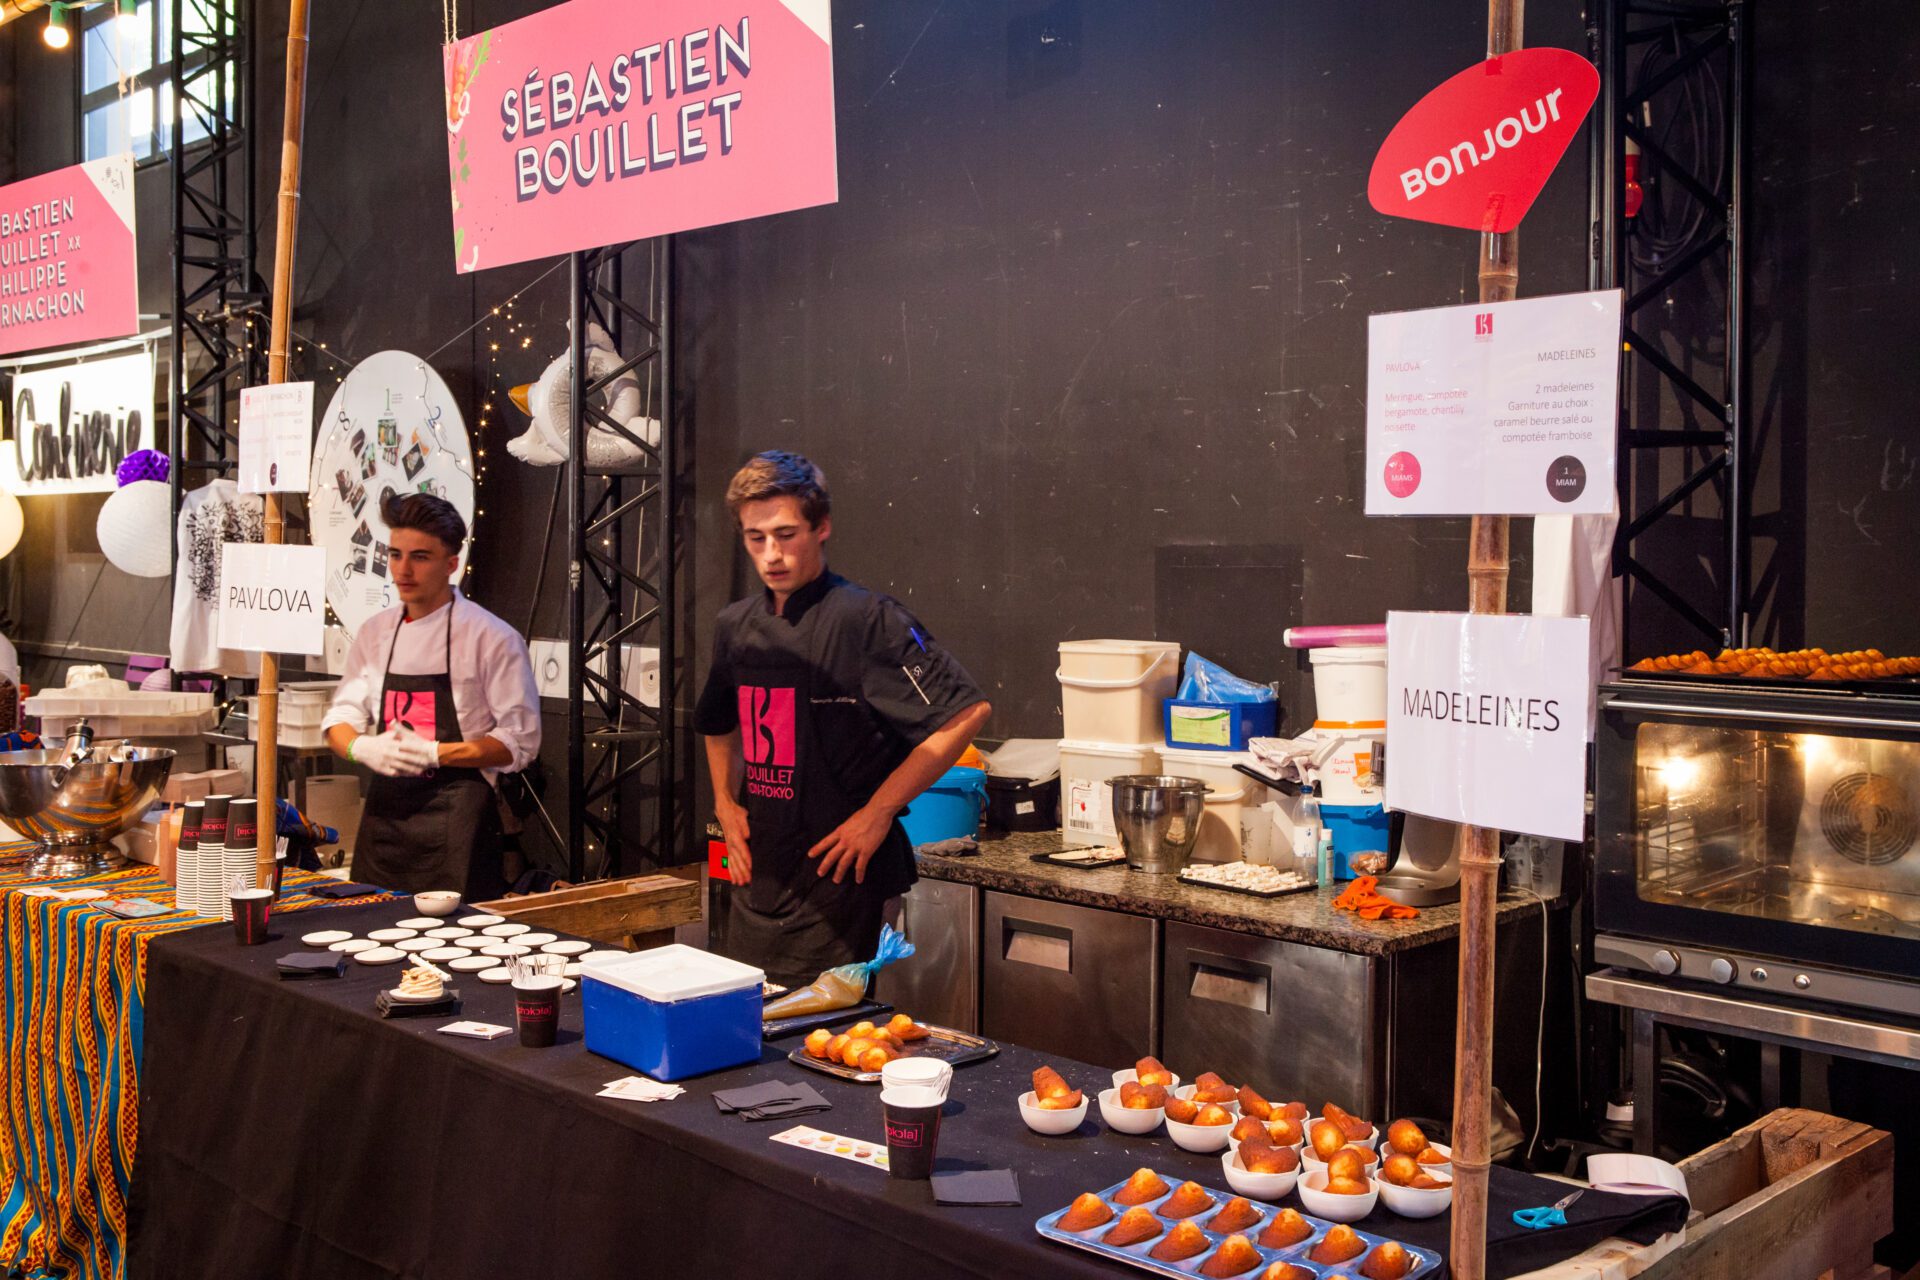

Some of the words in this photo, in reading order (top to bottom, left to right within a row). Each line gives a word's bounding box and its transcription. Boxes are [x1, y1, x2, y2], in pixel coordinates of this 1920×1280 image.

[502, 16, 751, 142] SÉBASTIEN
[515, 91, 742, 202] BOUILLET
[1, 196, 74, 237] BASTIEN
[1, 231, 61, 267] UILLET
[1, 261, 67, 296] HILIPPE
[1, 289, 85, 326] RNACHON
[1385, 362, 1421, 373] PAVLOVA
[1537, 348, 1596, 362] MADELEINES
[1535, 384, 1541, 394] 2
[1543, 382, 1594, 393] madeleines
[1508, 401, 1550, 411] Garniture
[1552, 401, 1563, 409] au
[1565, 398, 1588, 408] choix
[1494, 416, 1528, 427] caramel
[1530, 416, 1560, 426] beurre
[1562, 413, 1579, 424] salé
[1502, 431, 1546, 443] compotée
[1549, 430, 1592, 441] framboise
[1556, 478, 1577, 486] MIAM
[229, 586, 312, 613] PAVLOVA
[1403, 687, 1560, 731] MADELEINES
